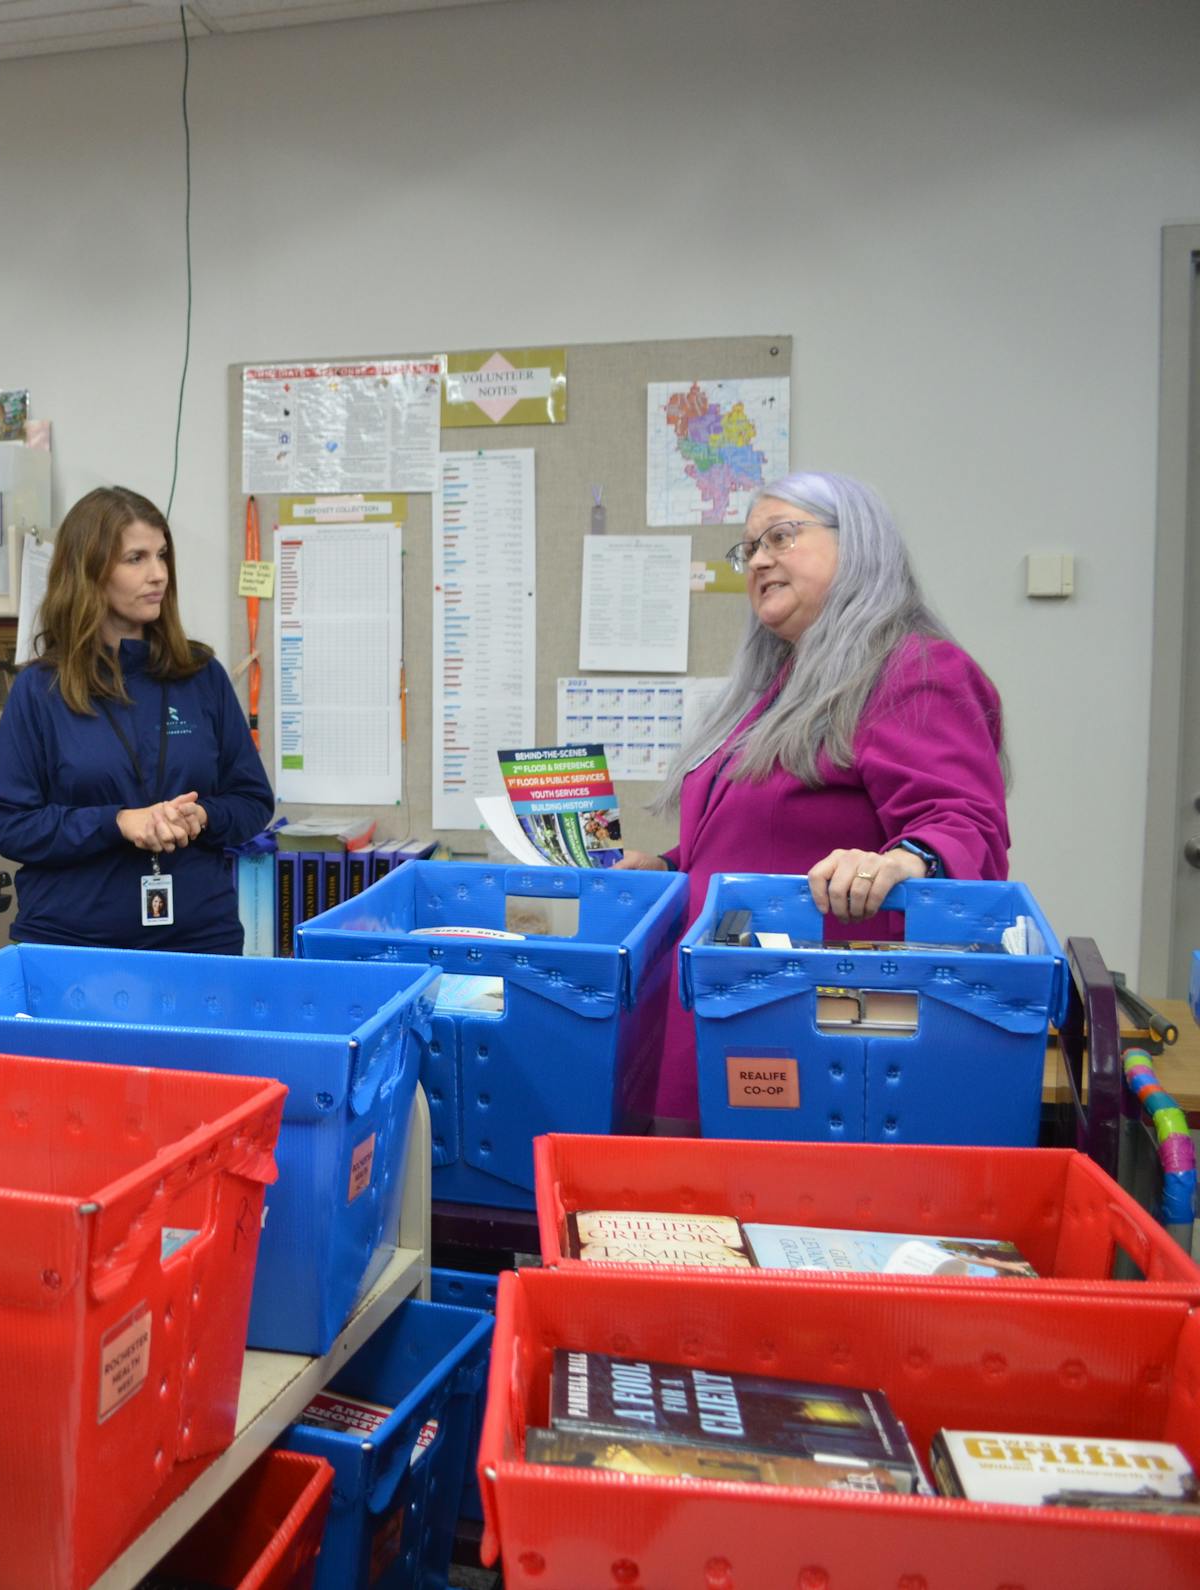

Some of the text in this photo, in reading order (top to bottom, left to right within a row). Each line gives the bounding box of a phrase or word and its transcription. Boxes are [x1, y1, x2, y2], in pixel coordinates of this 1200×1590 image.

[461, 370, 534, 384] VOLUNTEER
[478, 385, 518, 397] NOTES
[514, 748, 588, 761] BEHIND-THE-SCENES
[523, 763, 547, 773] FLOOR
[554, 760, 596, 771] REFERENCE
[516, 777, 539, 787] FLOOR
[545, 775, 571, 785] PUBLIC
[571, 772, 606, 783] SERVICES
[529, 787, 590, 799] YOUTH SERVICES
[562, 800, 594, 810] HISTORY
[740, 1071, 787, 1081] REALIFE
[743, 1086, 784, 1095] CO-OP
[597, 1219, 719, 1234] PHILIPPA
[587, 1230, 731, 1245] GREGORY
[601, 1246, 727, 1262] TAMING
[779, 1238, 806, 1269] GRAZE
[104, 1331, 150, 1376] ROCHESTER
[112, 1354, 141, 1385] HEALTH
[567, 1352, 589, 1417] PARNELL HALL
[610, 1361, 656, 1424] A FOOL
[660, 1378, 689, 1414] FOR A
[691, 1369, 745, 1438] CLIENT
[963, 1437, 1174, 1472] Griffin
